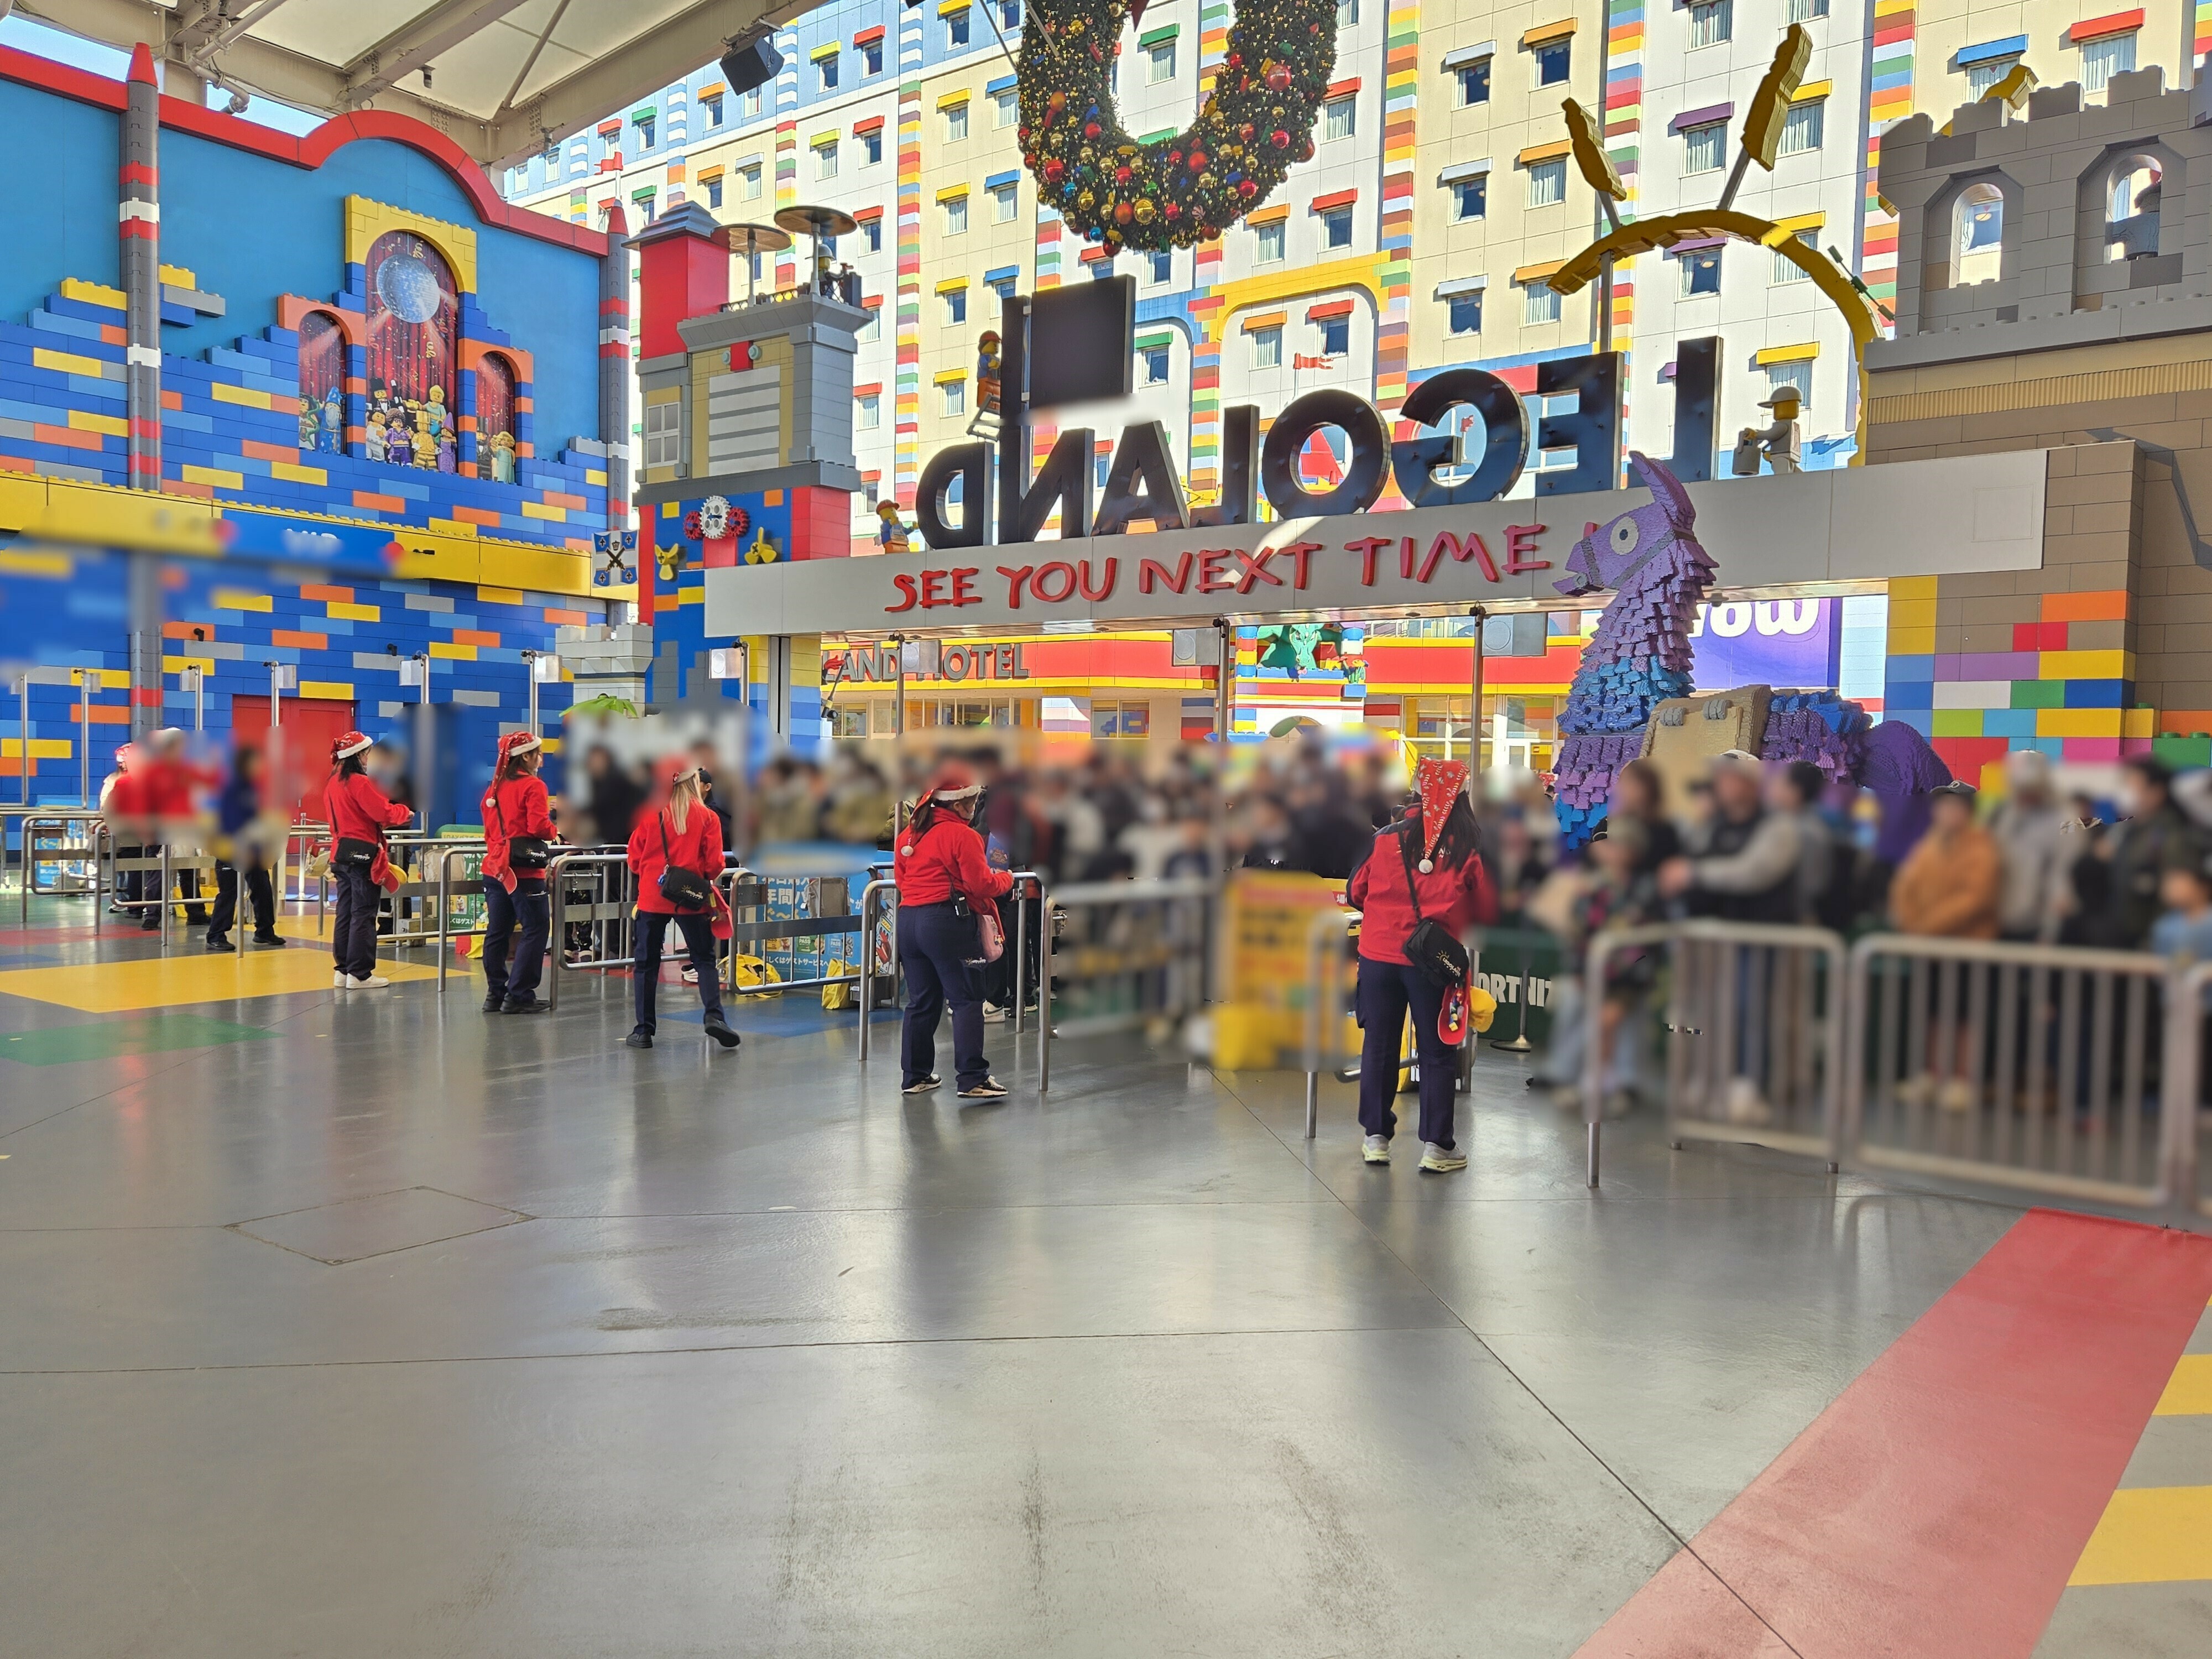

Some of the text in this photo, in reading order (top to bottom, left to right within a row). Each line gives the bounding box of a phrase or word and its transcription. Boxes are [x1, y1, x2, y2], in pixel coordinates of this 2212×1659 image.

[885, 523, 1551, 612] SEE YOU NEXT TIME
[917, 643, 1029, 682] OTEL
[765, 956, 829, 967] しくはゲストサービスへ
